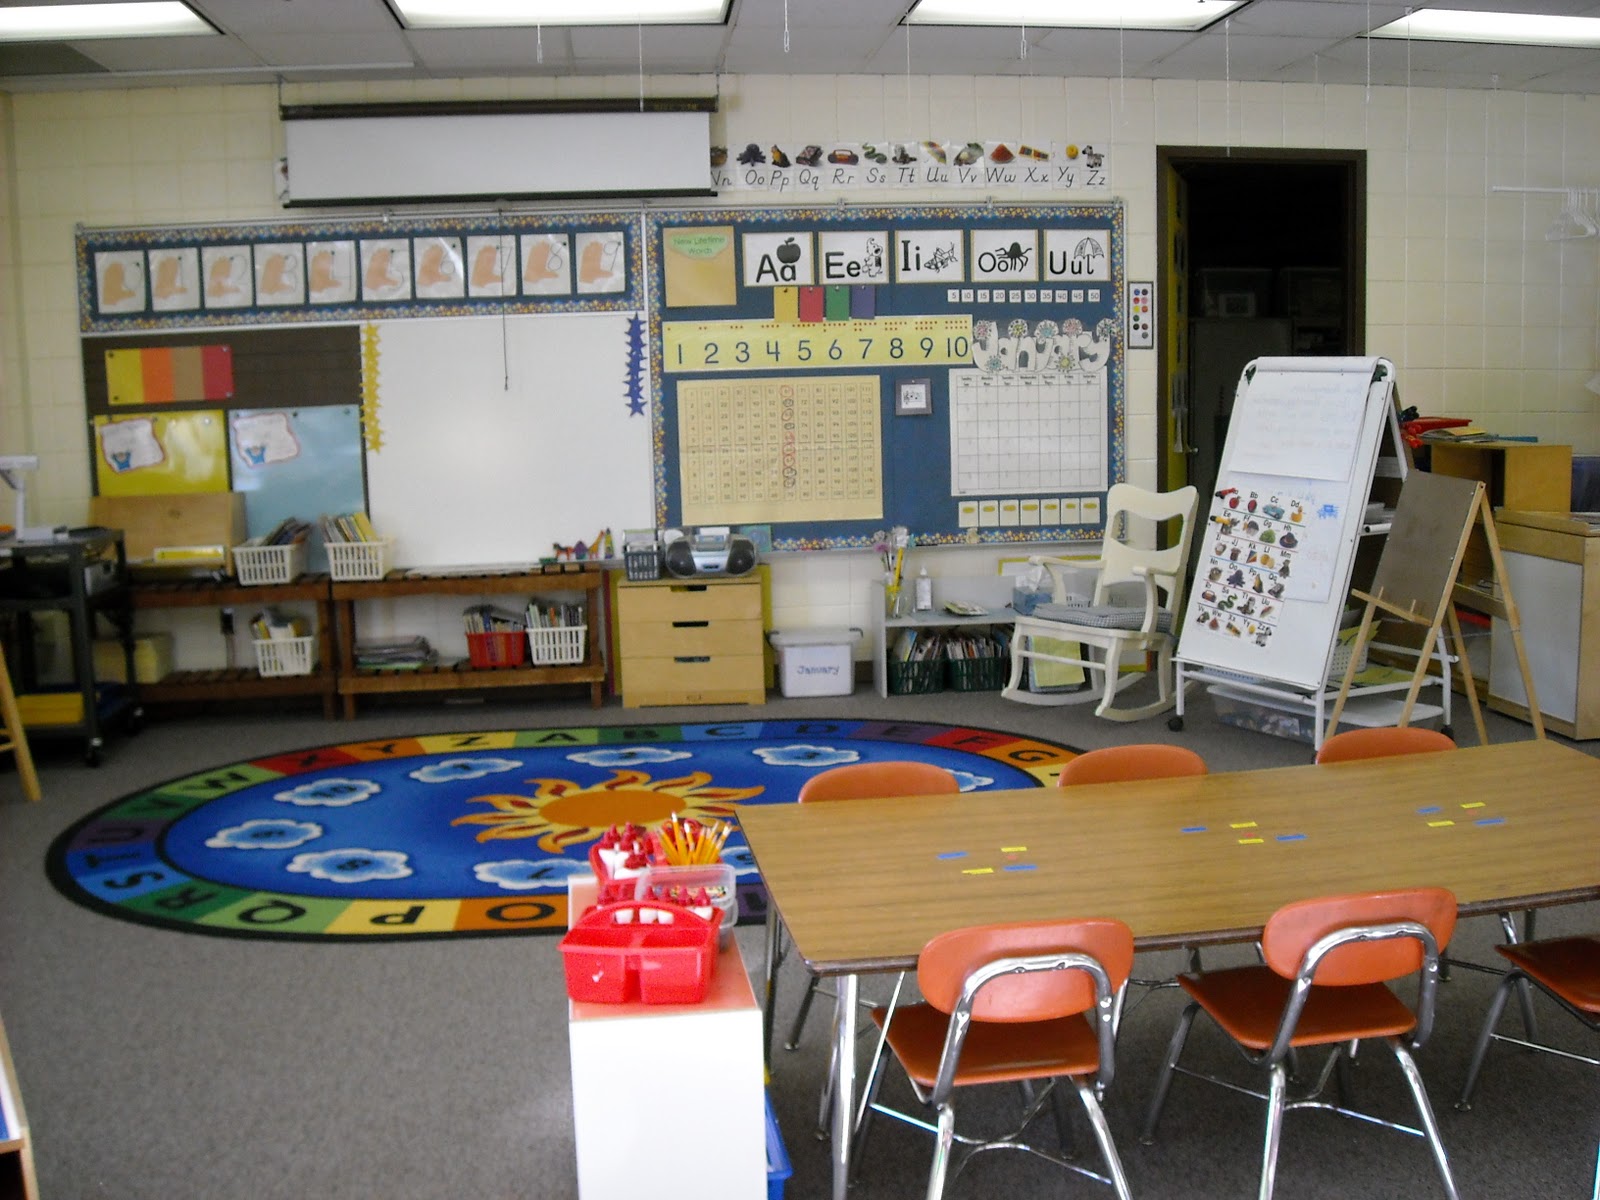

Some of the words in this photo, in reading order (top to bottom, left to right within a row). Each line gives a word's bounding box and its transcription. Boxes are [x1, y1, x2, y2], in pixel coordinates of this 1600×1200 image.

[745, 170, 765, 185] Oo
[770, 170, 789, 192] Pp
[799, 169, 819, 190] Qq
[832, 168, 855, 184] Rr
[866, 167, 886, 183] Ss
[898, 167, 914, 183] Tt
[926, 167, 949, 183] Uu
[958, 168, 977, 183] Vv
[986, 167, 1016, 183] Ww
[1024, 167, 1049, 183] Xx
[1057, 166, 1074, 188] Yy
[1087, 170, 1105, 186] Zz
[825, 251, 861, 279] Ee
[901, 240, 921, 271] Ii
[978, 252, 1009, 273] Oo
[755, 253, 796, 283] Aa
[678, 344, 682, 364] 1
[704, 343, 719, 364] 2
[735, 341, 750, 363] 3
[766, 340, 781, 362] 4
[798, 340, 812, 361] 5
[828, 339, 843, 360] 6
[858, 338, 873, 359] 7
[890, 337, 904, 359] 8
[920, 337, 934, 358] 9
[947, 336, 968, 358] 10
[972, 319, 1111, 373] January
[1250, 491, 1258, 499] Bb
[1290, 500, 1300, 508] Dd
[1223, 510, 1231, 518] Ee
[1263, 519, 1272, 528] Gg
[1229, 562, 1237, 571] Oo
[797, 665, 840, 676] January
[450, 735, 491, 747] Z
[537, 733, 579, 743] A
[705, 726, 745, 737] C
[953, 735, 997, 748] F
[1008, 750, 1059, 762] G
[85, 853, 141, 868] T
[103, 870, 164, 889] S
[154, 888, 221, 911] R
[237, 899, 307, 924] Q
[370, 905, 426, 926] P
[485, 902, 556, 923] O
